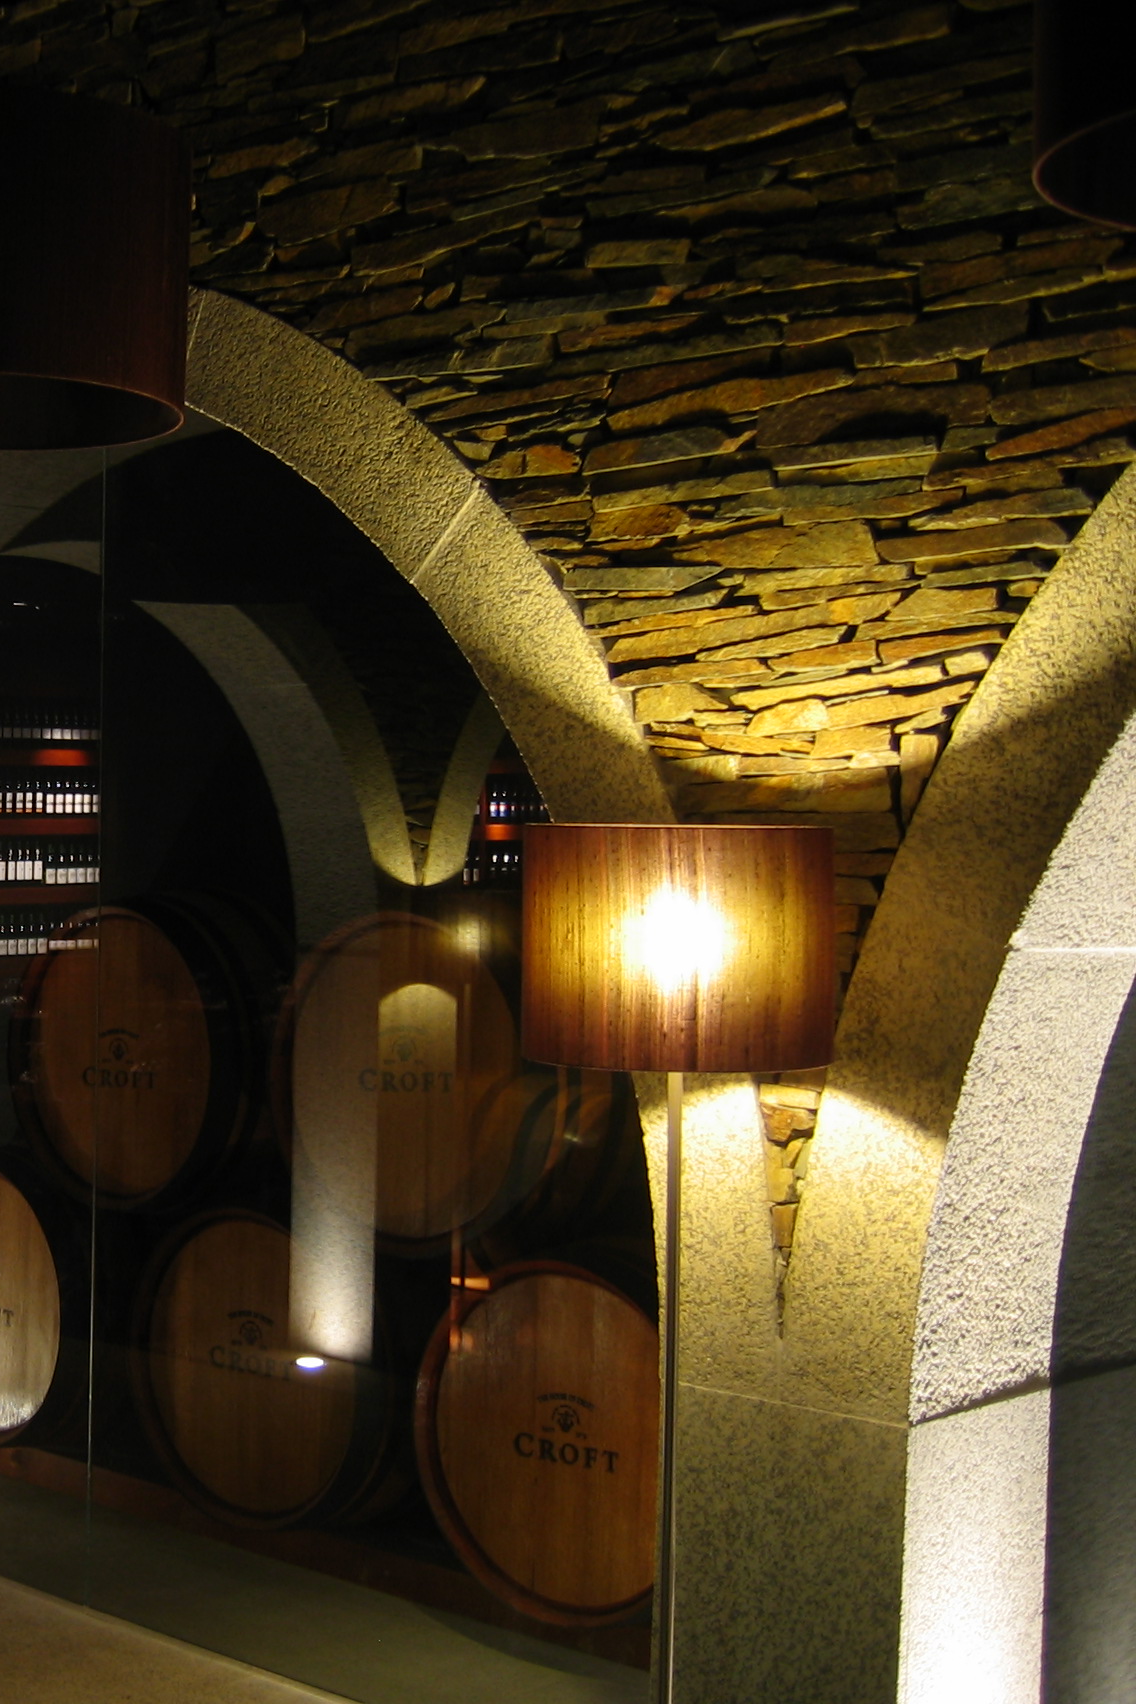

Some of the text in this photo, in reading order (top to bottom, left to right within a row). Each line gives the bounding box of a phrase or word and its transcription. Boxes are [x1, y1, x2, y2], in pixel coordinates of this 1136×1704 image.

[82, 1066, 156, 1088] CROFT
[358, 1068, 452, 1093] CROFT
[210, 1345, 291, 1381] CROFT
[513, 1432, 619, 1473] CROFT
